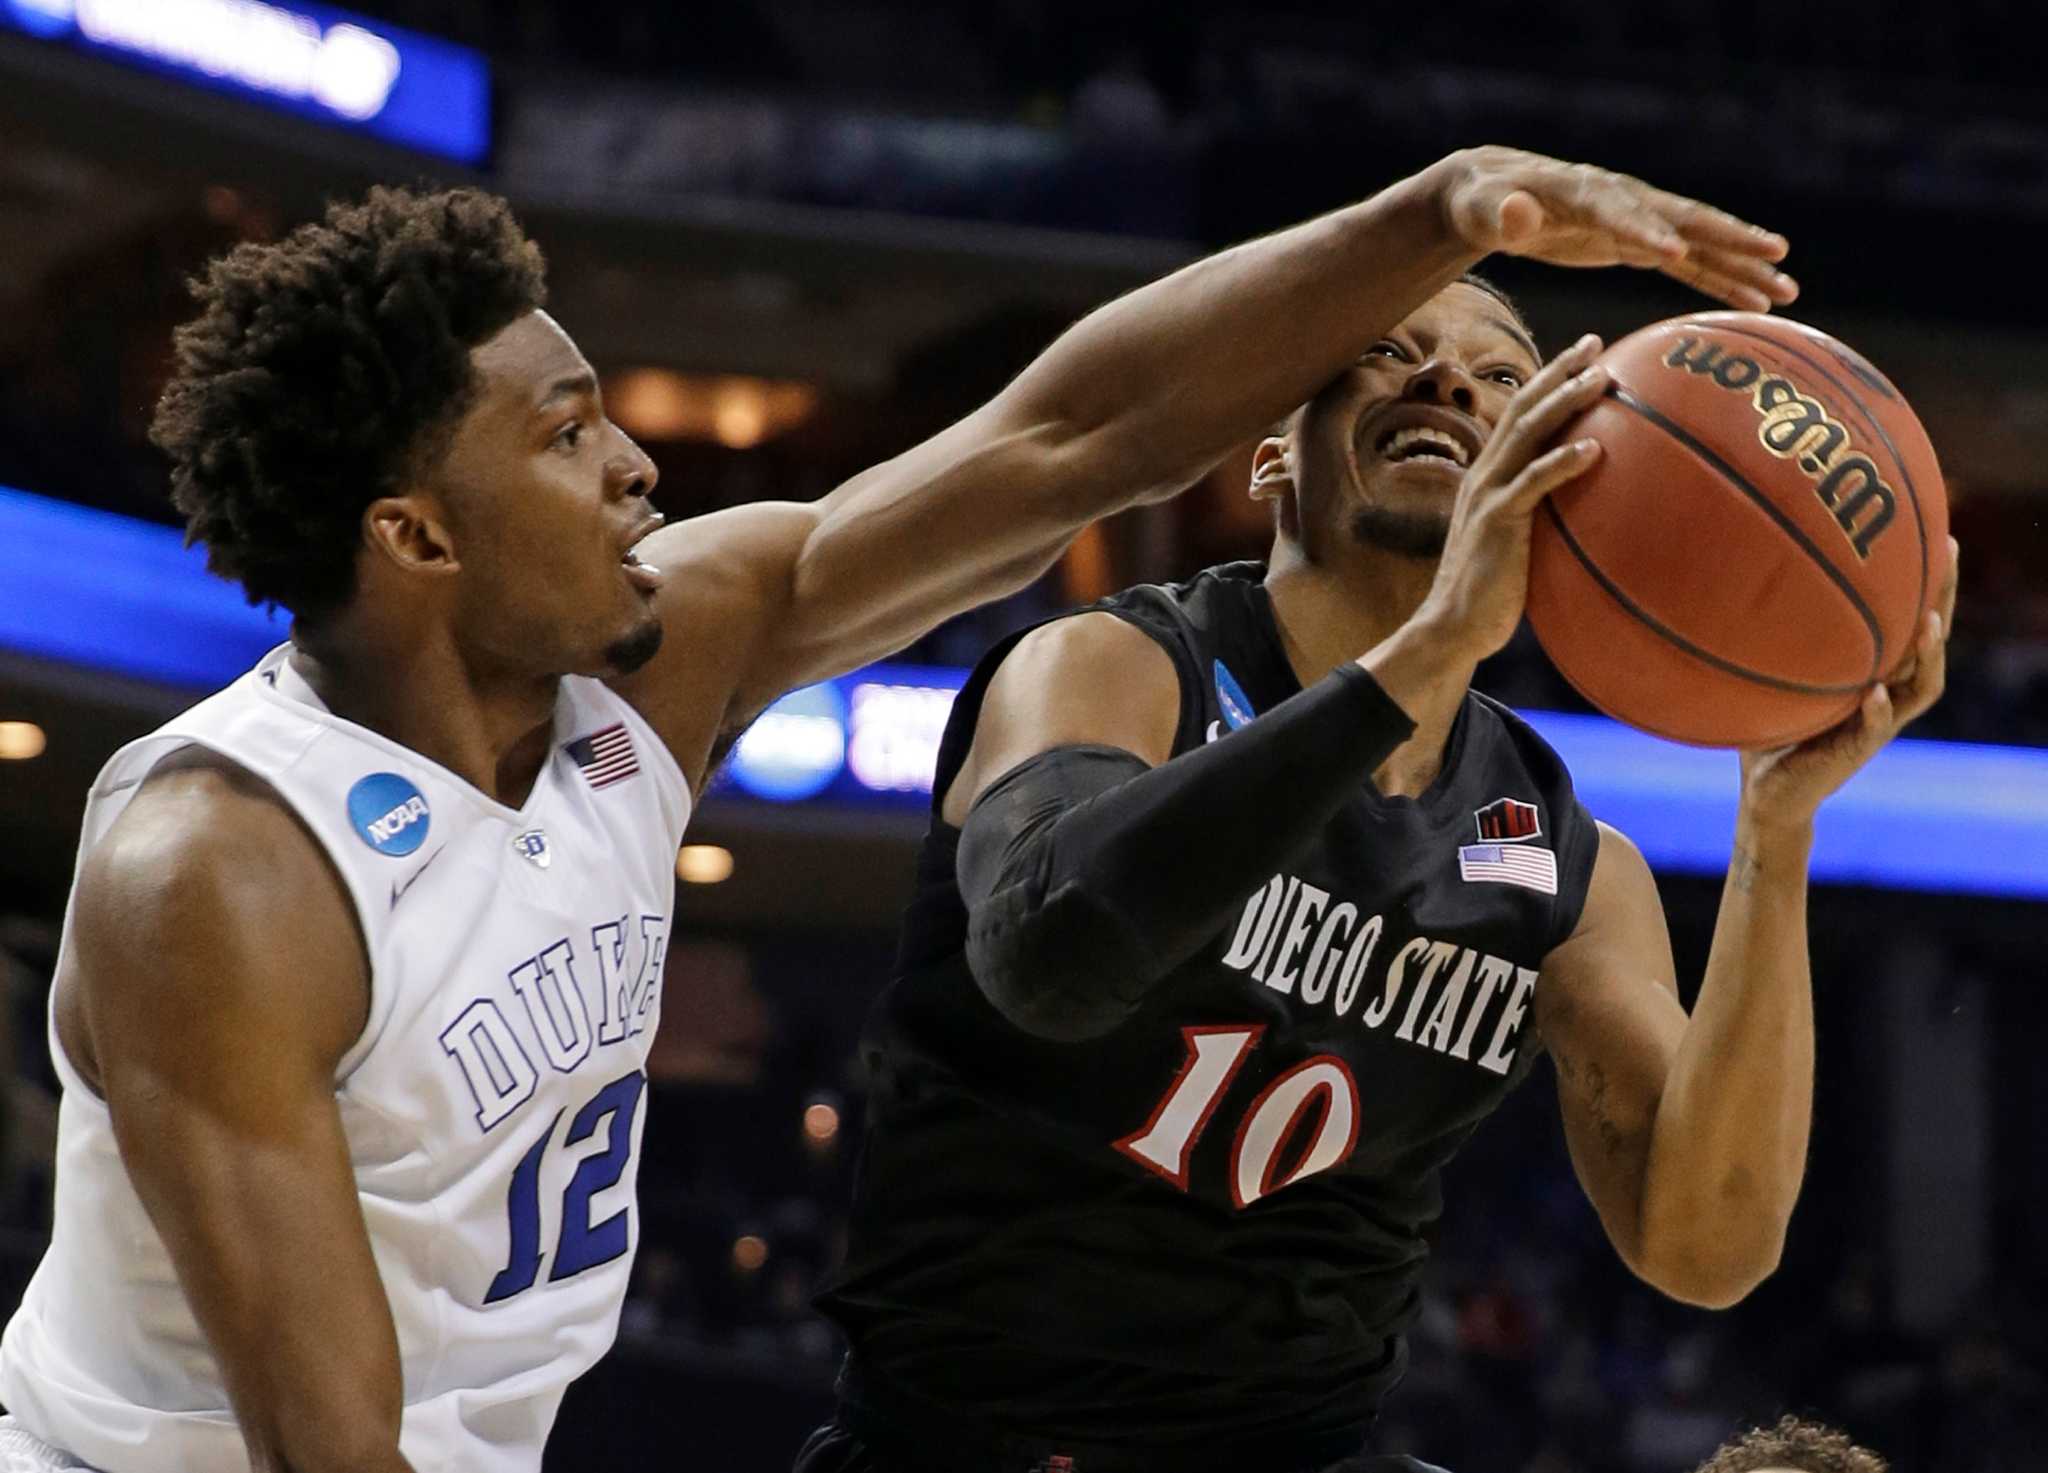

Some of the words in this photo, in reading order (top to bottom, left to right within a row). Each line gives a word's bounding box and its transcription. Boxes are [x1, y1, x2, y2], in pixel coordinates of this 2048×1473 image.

[1662, 337, 1897, 565] Wilson
[367, 796, 429, 844] NCAA
[438, 915, 664, 1134] DUKE
[1221, 873, 1384, 1017] DIEGO
[1362, 936, 1540, 1076] STATE
[482, 1069, 648, 1305] 12
[1111, 1023, 1361, 1209] 10
